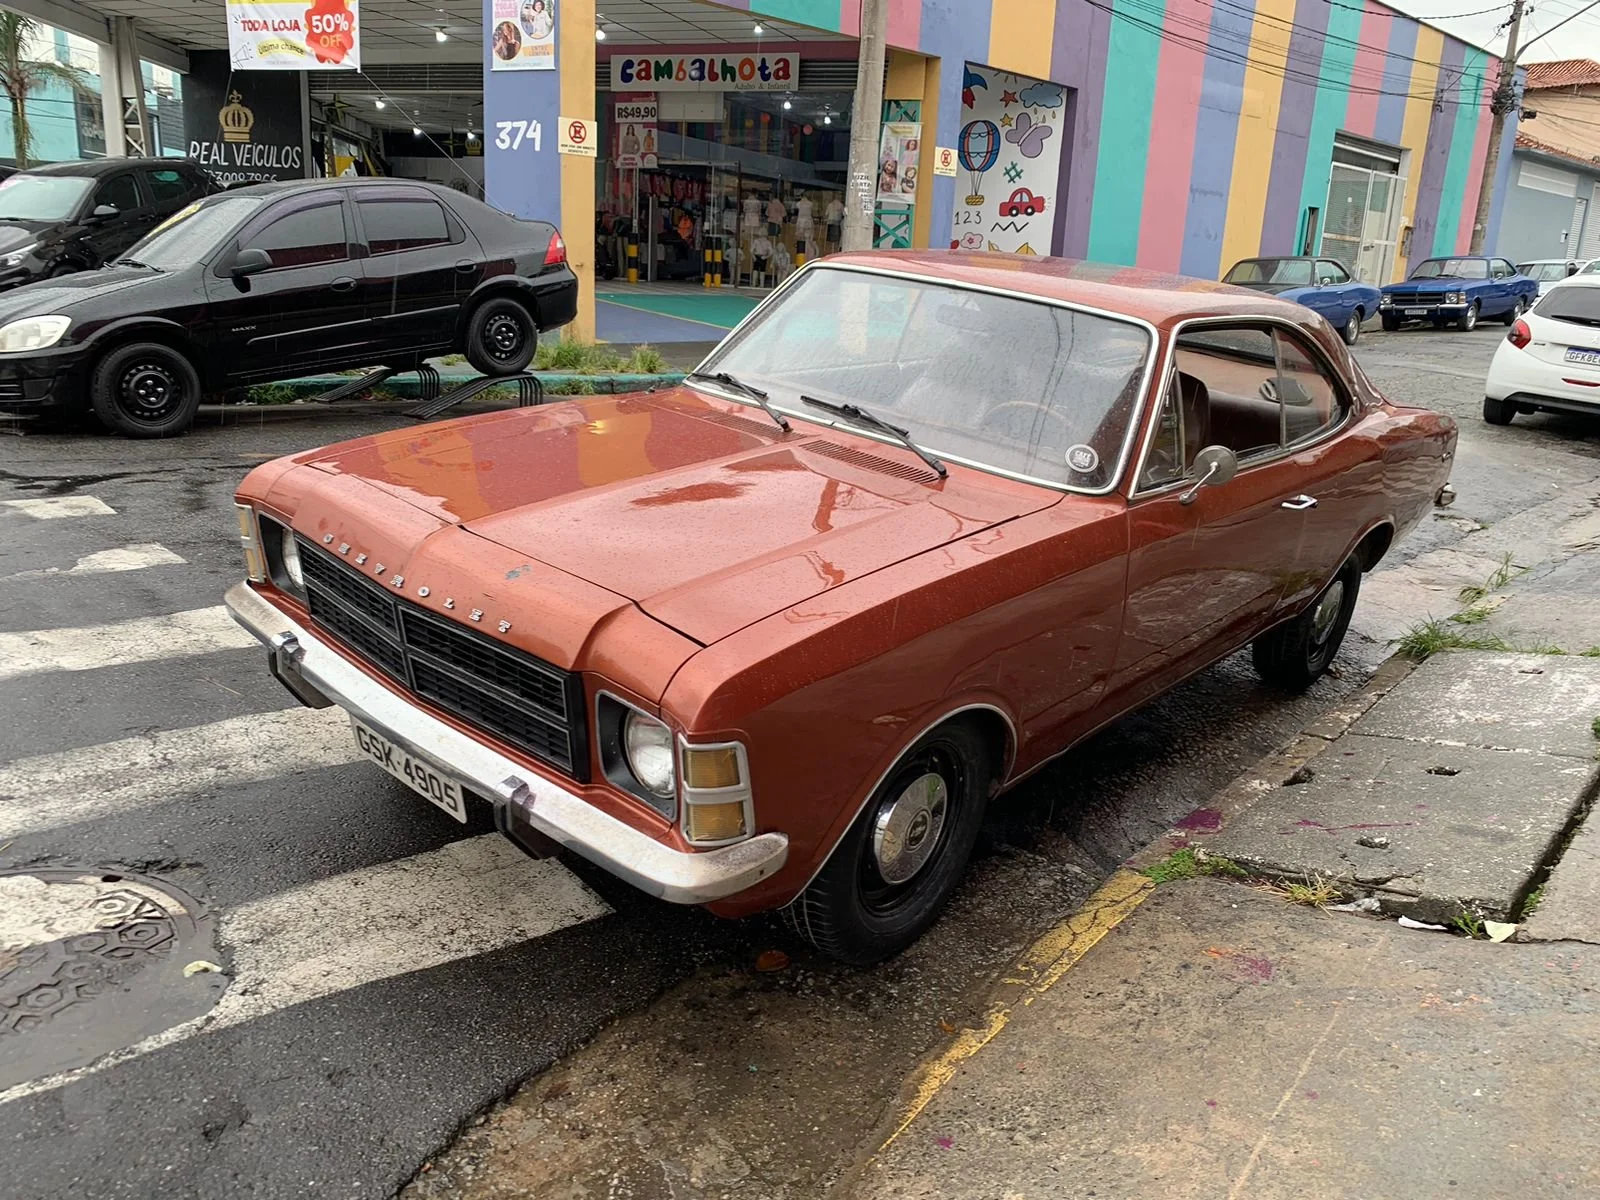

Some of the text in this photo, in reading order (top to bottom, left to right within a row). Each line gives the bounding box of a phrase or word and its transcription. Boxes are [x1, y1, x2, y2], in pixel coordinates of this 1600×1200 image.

[241, 19, 301, 31] TODA LOJA
[311, 13, 349, 34] 50%
[320, 35, 343, 48] OFF
[617, 106, 657, 120] R$49,90
[495, 119, 541, 152] 374
[189, 141, 302, 169] REAL VEÍCULOS
[1570, 351, 1600, 364] GFK8E
[322, 532, 512, 634] CHEVROLET
